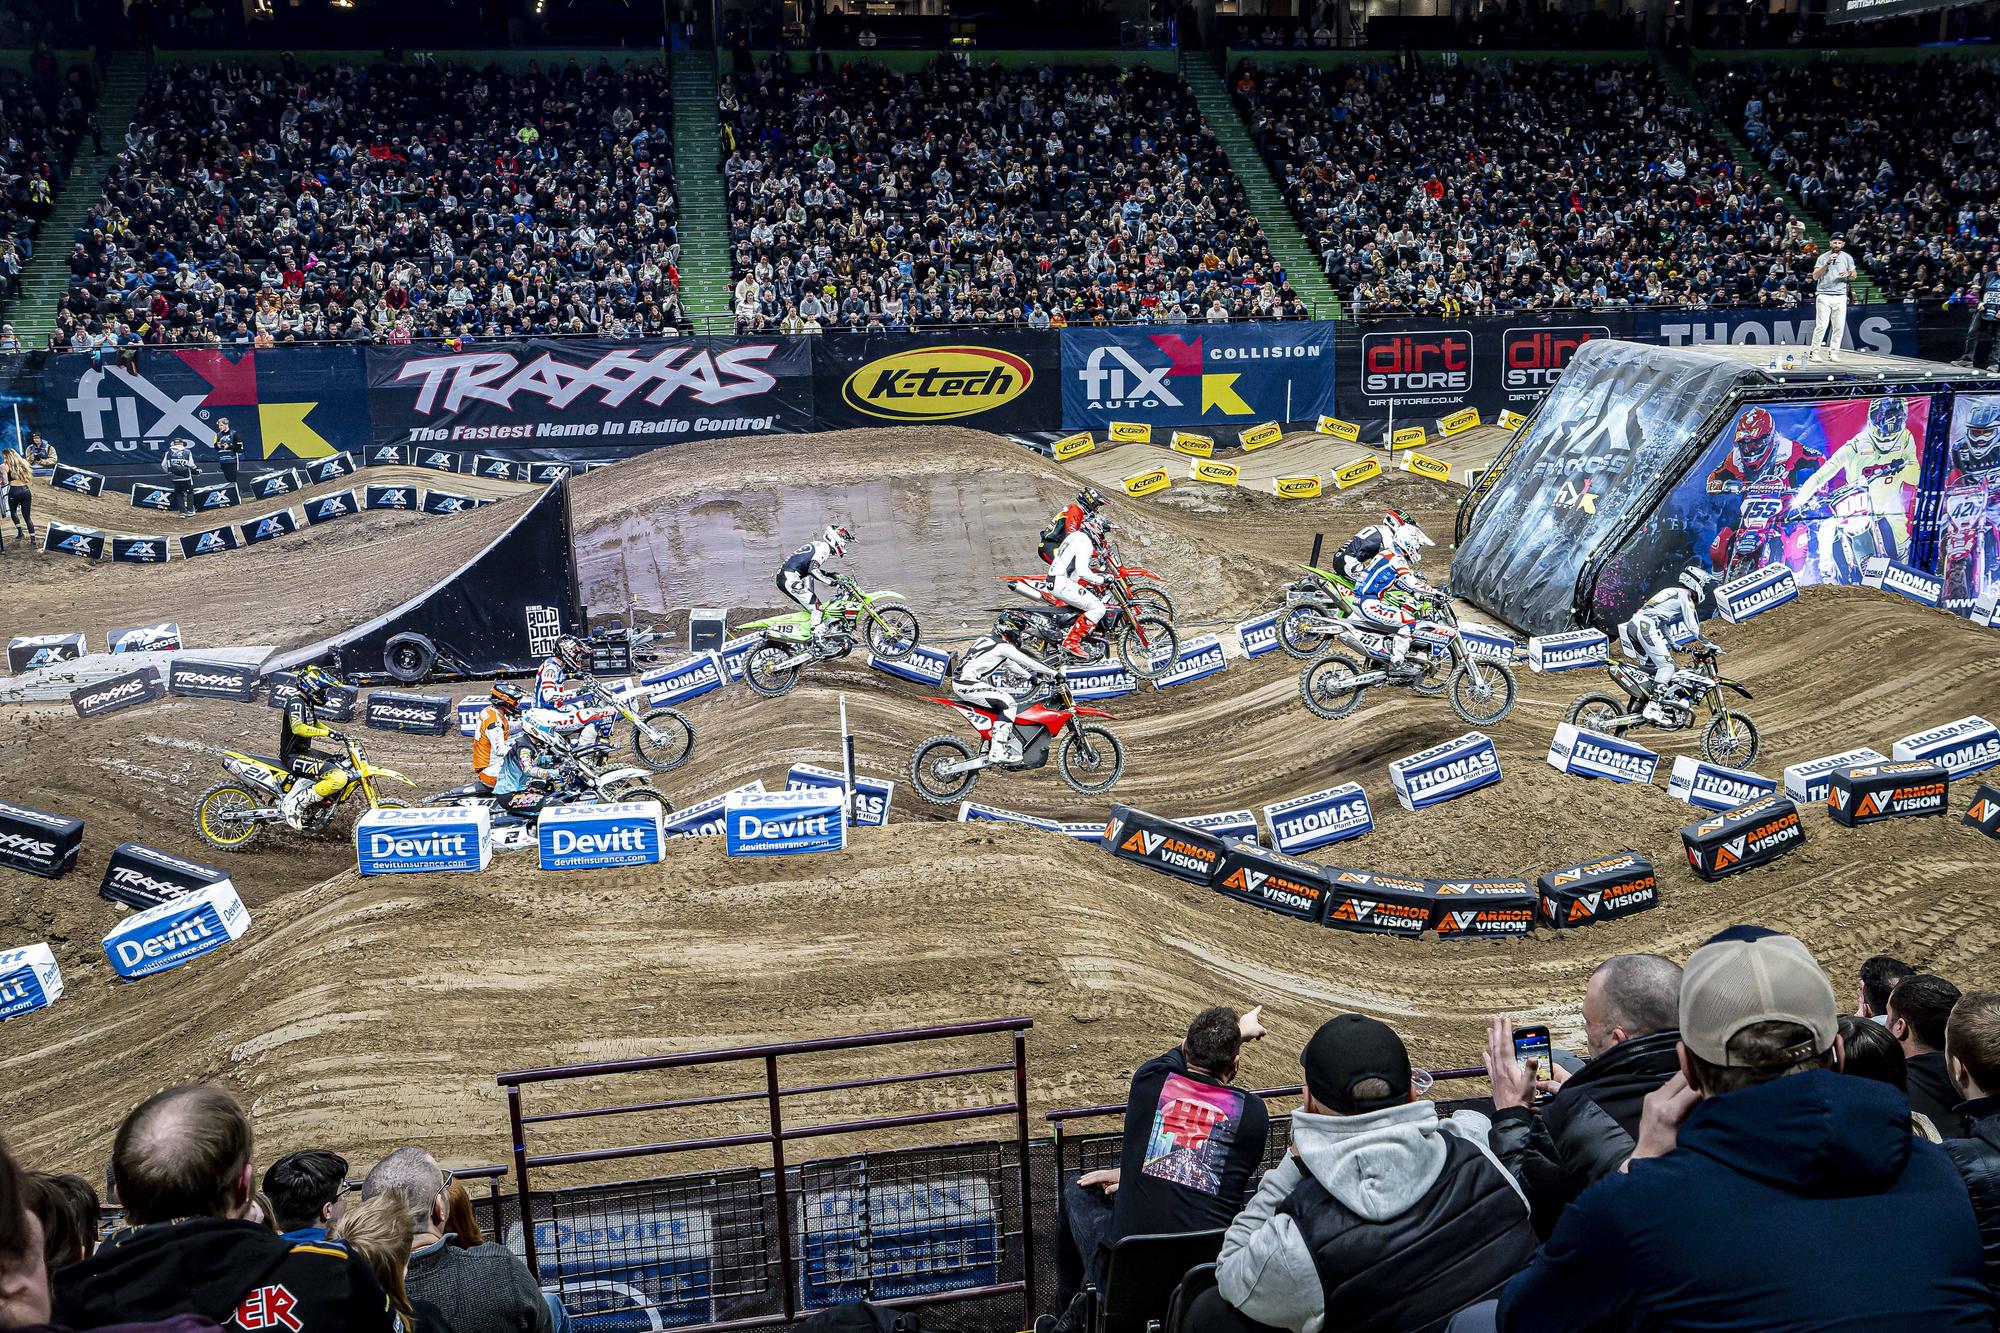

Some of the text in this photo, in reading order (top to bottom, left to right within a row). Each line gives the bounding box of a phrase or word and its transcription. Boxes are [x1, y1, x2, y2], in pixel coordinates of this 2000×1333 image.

[1210, 345, 1321, 360] COLLISION
[1368, 338, 1467, 373] dirt
[398, 344, 778, 415] TRAXXAS
[1367, 371, 1467, 391] STORE
[1508, 369, 1562, 385] STO
[1087, 399, 1159, 410] AUTO
[1368, 396, 1464, 406] DIRTSTORE.CO.UK
[409, 415, 774, 442] The Fastest Name In Radio Control
[1746, 502, 1777, 518] 155
[1719, 564, 1782, 595] THOMAS
[1888, 567, 1941, 595] THOMAS
[1730, 577, 1794, 613] THOMAS
[777, 624, 794, 634] 119
[1537, 629, 1599, 645] THOMAS
[1360, 633, 1378, 648] 151
[1542, 642, 1607, 663] THOMAS
[175, 671, 244, 687] TRAXXAS
[1068, 670, 1136, 690] THOMAS
[79, 678, 143, 710] TRAXXAS
[370, 705, 437, 721] TRAXXAS
[966, 711, 989, 725] 217
[1901, 719, 1985, 748] THOMAS
[1398, 734, 1481, 768] THOMAS
[1552, 740, 1571, 755] THOMAS
[1929, 738, 2000, 770] HOMAS
[1576, 740, 1655, 774] THOMAS
[1793, 750, 1876, 775] THOMAS
[1407, 749, 1495, 793] THOMAS
[1463, 764, 1496, 781] Plant Hire
[1617, 769, 1648, 782] Plant Hire
[1879, 761, 1931, 772] ARMOR
[1671, 774, 1691, 787] THOMAS
[742, 792, 829, 803] Devitt
[1271, 784, 1358, 814] THOMAS
[1786, 785, 1805, 803] THOMAS
[1893, 783, 1945, 800] ARMOR
[553, 803, 645, 815] Devitt
[1893, 795, 1941, 812] VISION
[377, 808, 472, 820] Devitt
[1276, 799, 1367, 839] THOMAS
[739, 814, 829, 840] Devitt
[1333, 816, 1367, 831] Plant Hire
[1746, 813, 1800, 844] ARMOR
[371, 831, 467, 859] Devitt
[553, 826, 646, 855] Devitt
[740, 841, 829, 852] devittinsurance.com
[1749, 825, 1799, 854] VISION
[1163, 839, 1216, 863] ARMOR
[128, 845, 220, 877] TRAXXAS
[373, 859, 467, 870] devittinsurance.com
[554, 854, 646, 867] devittinsurance.com
[1161, 849, 1209, 873] VISION
[1583, 855, 1634, 872] ARMOR
[1586, 859, 1636, 876] VISION
[112, 867, 190, 897] TRAXX
[1265, 876, 1320, 900] ARMOR
[1373, 876, 1425, 888] ARMOR
[1375, 880, 1425, 893] VISION
[1474, 887, 1527, 895] VISION
[1602, 877, 1655, 900] ARMOR
[1263, 886, 1312, 911] VISION
[1604, 888, 1654, 911] VISION
[223, 898, 241, 922] Devitt
[1374, 903, 1430, 920] ARMOR
[1476, 910, 1533, 921] ARMOR
[1373, 914, 1423, 931] VISION
[1475, 921, 1527, 931] VISION
[116, 914, 213, 968] Devitt
[130, 937, 218, 977] devittinsurance.com
